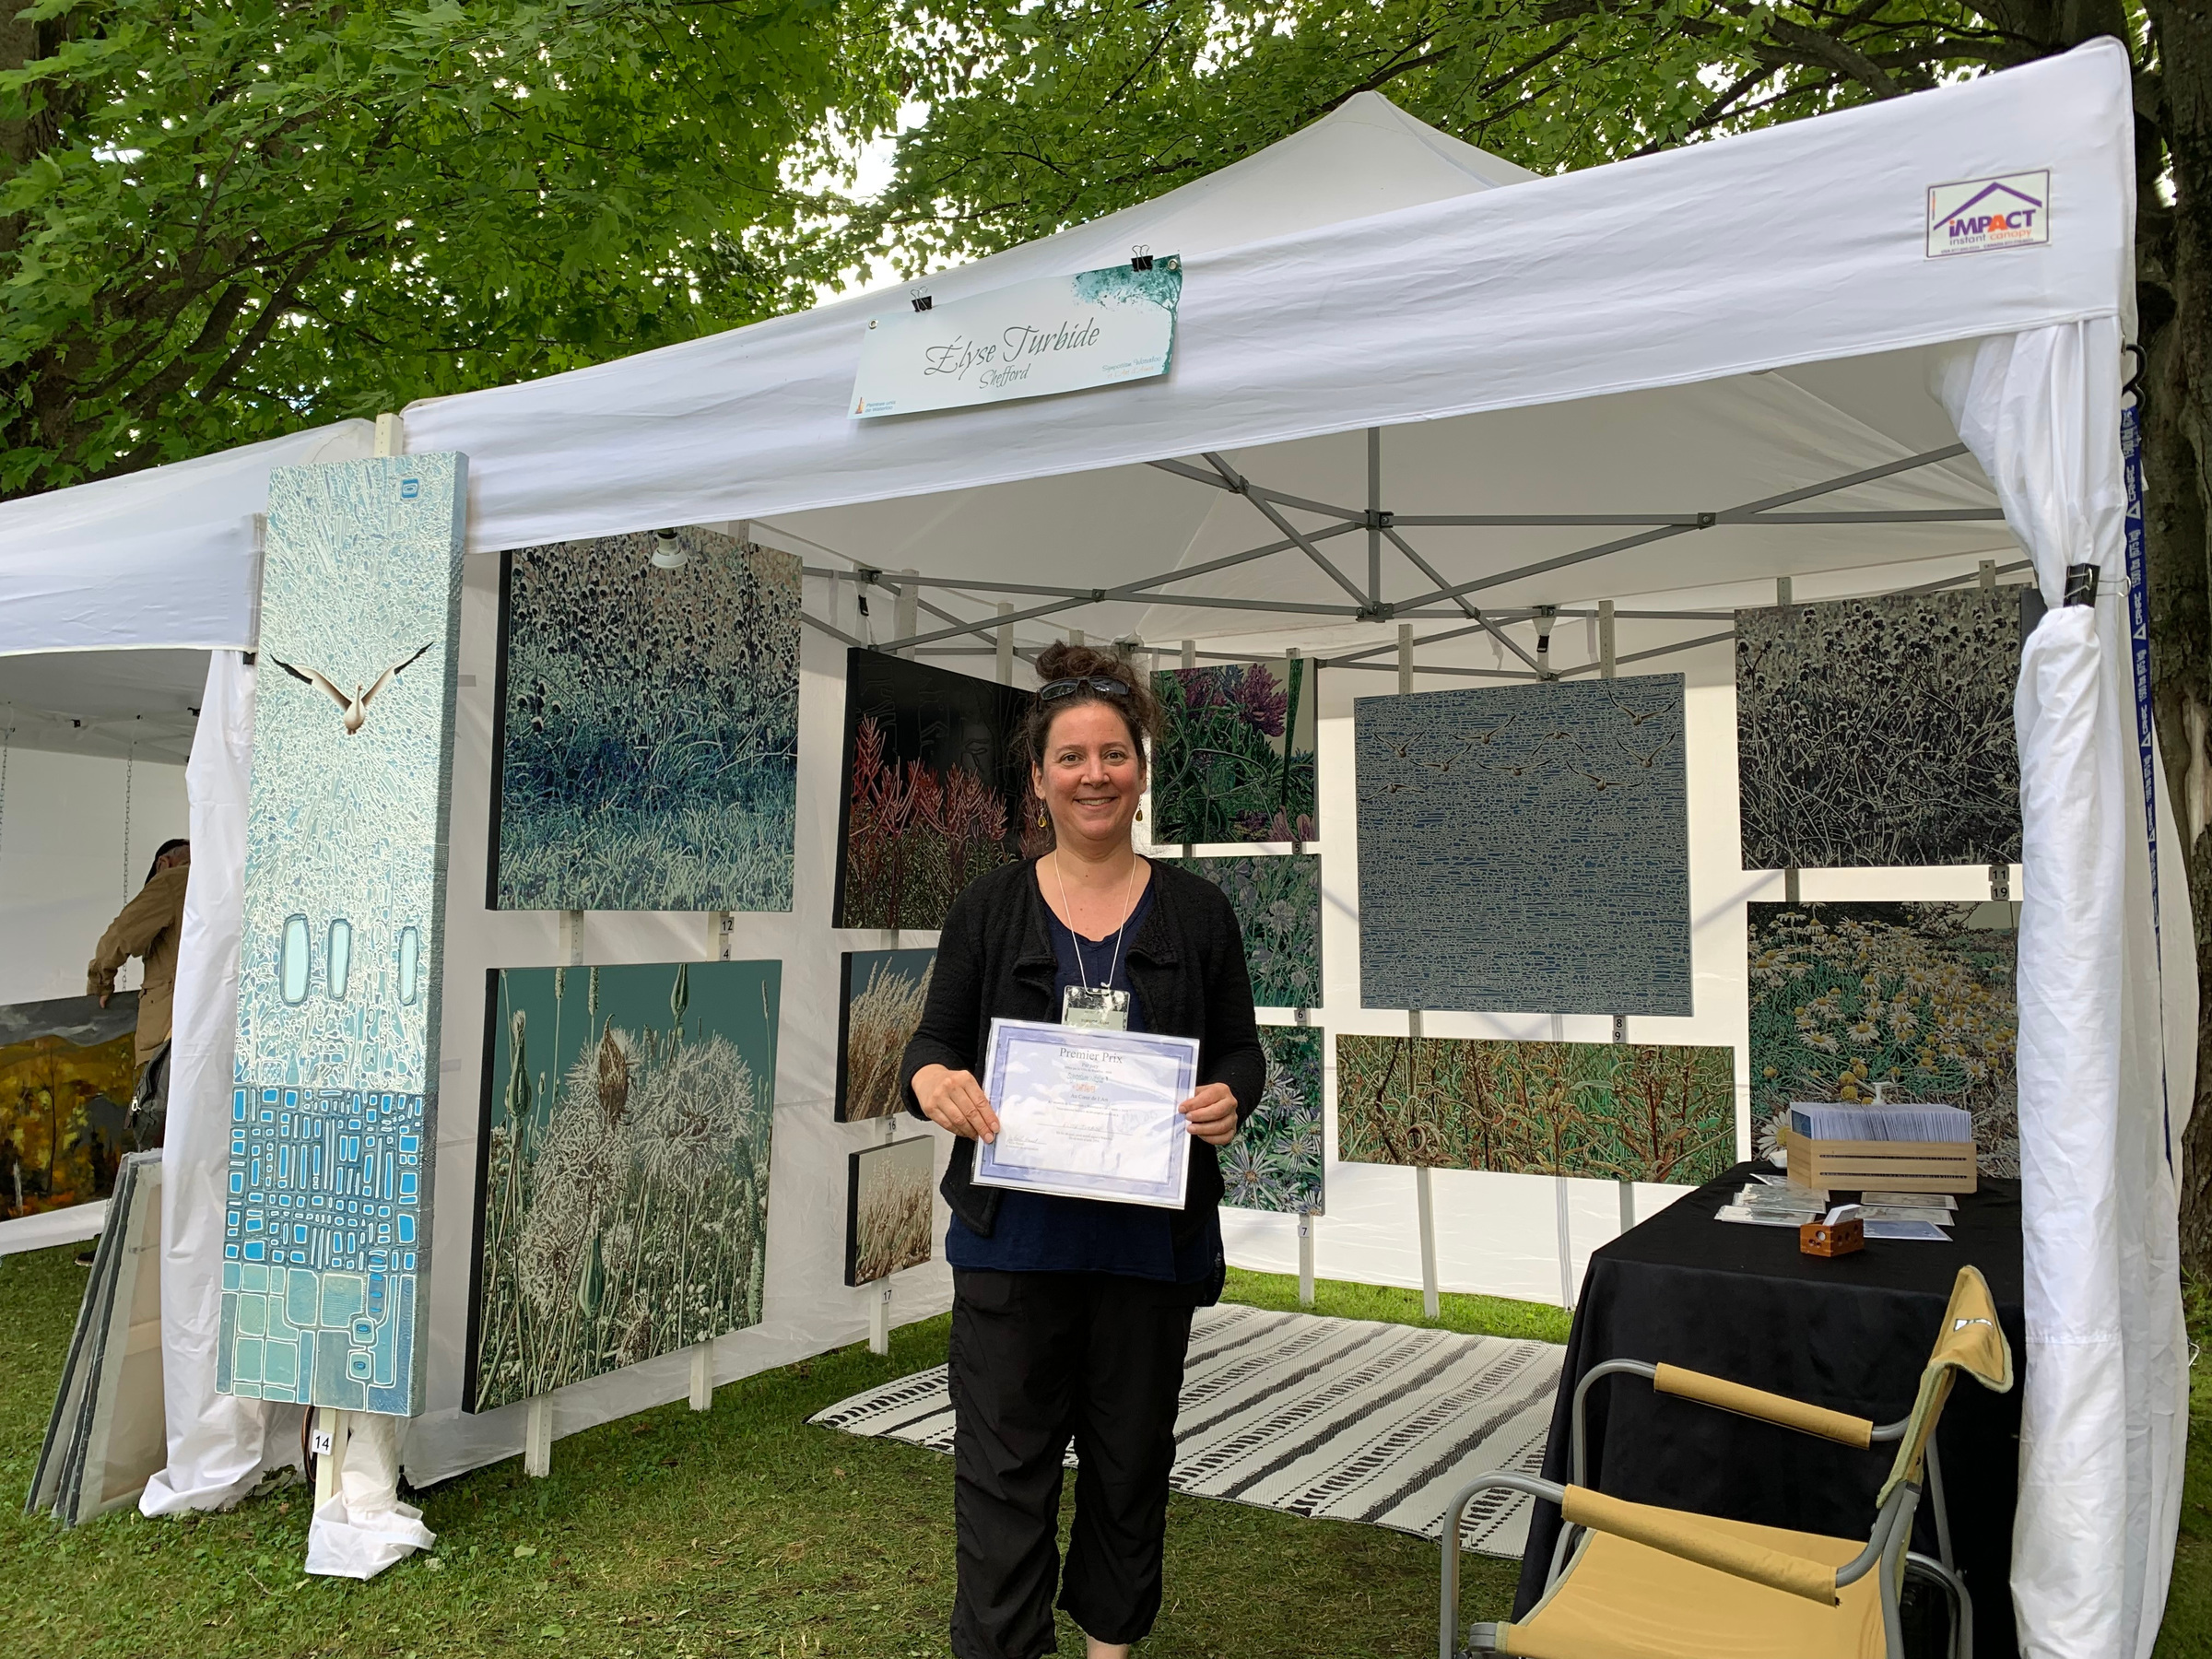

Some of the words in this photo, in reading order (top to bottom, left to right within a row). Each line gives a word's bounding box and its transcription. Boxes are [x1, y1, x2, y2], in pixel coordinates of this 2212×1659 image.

[1949, 234, 1986, 246] instant
[1989, 228, 2032, 241] canopy
[924, 335, 996, 381] Élyse
[1002, 317, 1100, 362] Turbide
[979, 363, 1030, 389] Shefford
[2126, 465, 2136, 502] CANAC
[2134, 591, 2143, 626] CANAC
[1295, 843, 1300, 853] 5
[1992, 869, 2006, 879] 11
[1993, 887, 2008, 898] 19
[722, 920, 734, 931] 12
[723, 948, 730, 959] 4
[1298, 1010, 1304, 1019] 6
[1616, 1018, 1623, 1029] 8
[1614, 1031, 1621, 1041] 9
[1059, 1047, 1100, 1062] Premier
[1101, 1052, 1124, 1064] Prix
[888, 1120, 897, 1131] 16
[1301, 1227, 1308, 1236] 7
[883, 1289, 892, 1300] 17
[314, 1435, 330, 1451] 14
